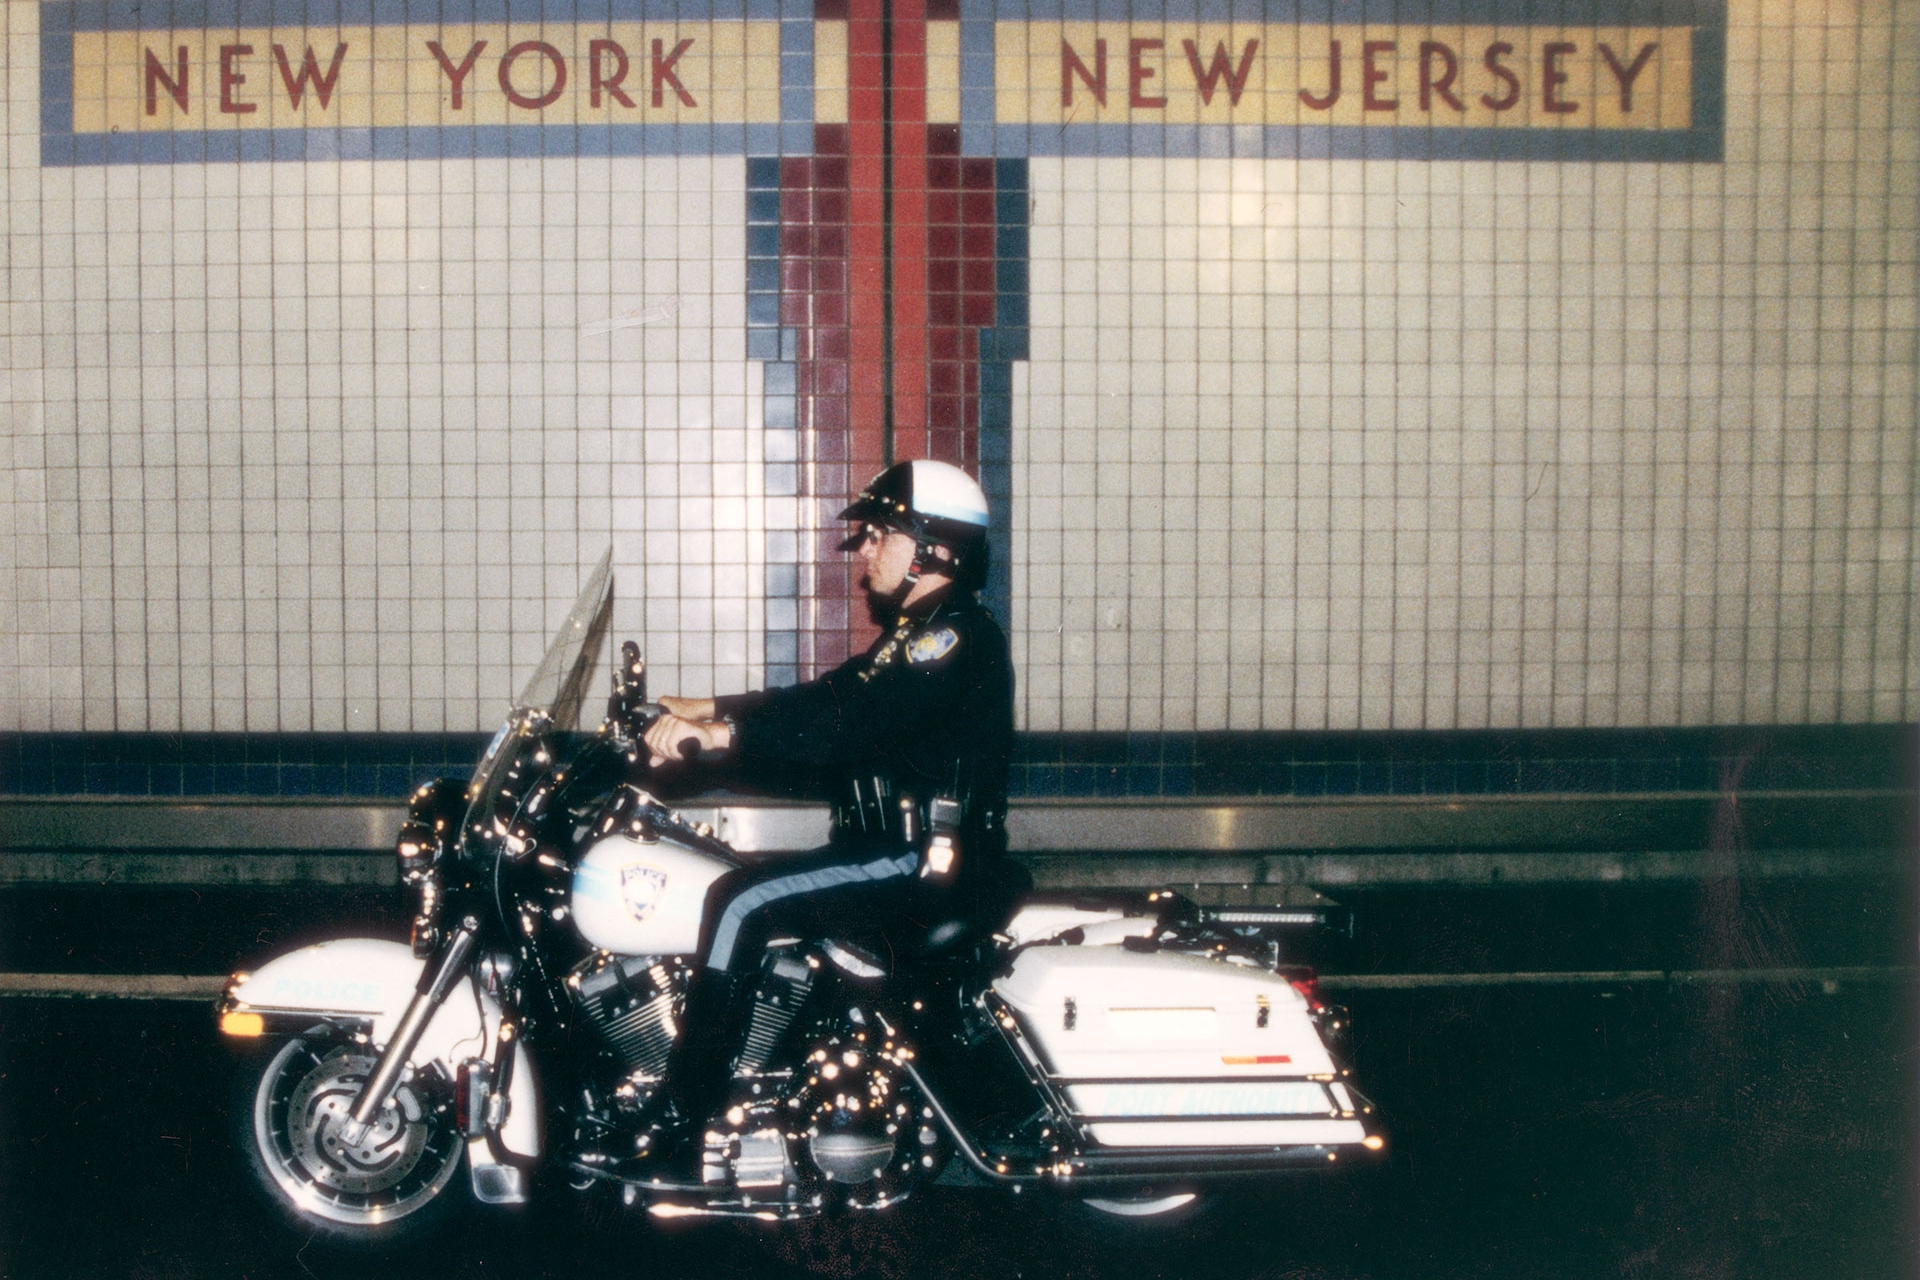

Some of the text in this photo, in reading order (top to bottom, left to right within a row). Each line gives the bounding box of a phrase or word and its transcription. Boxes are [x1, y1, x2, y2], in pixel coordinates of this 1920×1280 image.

[144, 38, 699, 116] NEW YORK
[1060, 38, 1659, 113] NEW JERSEY
[272, 978, 381, 1003] POLICE
